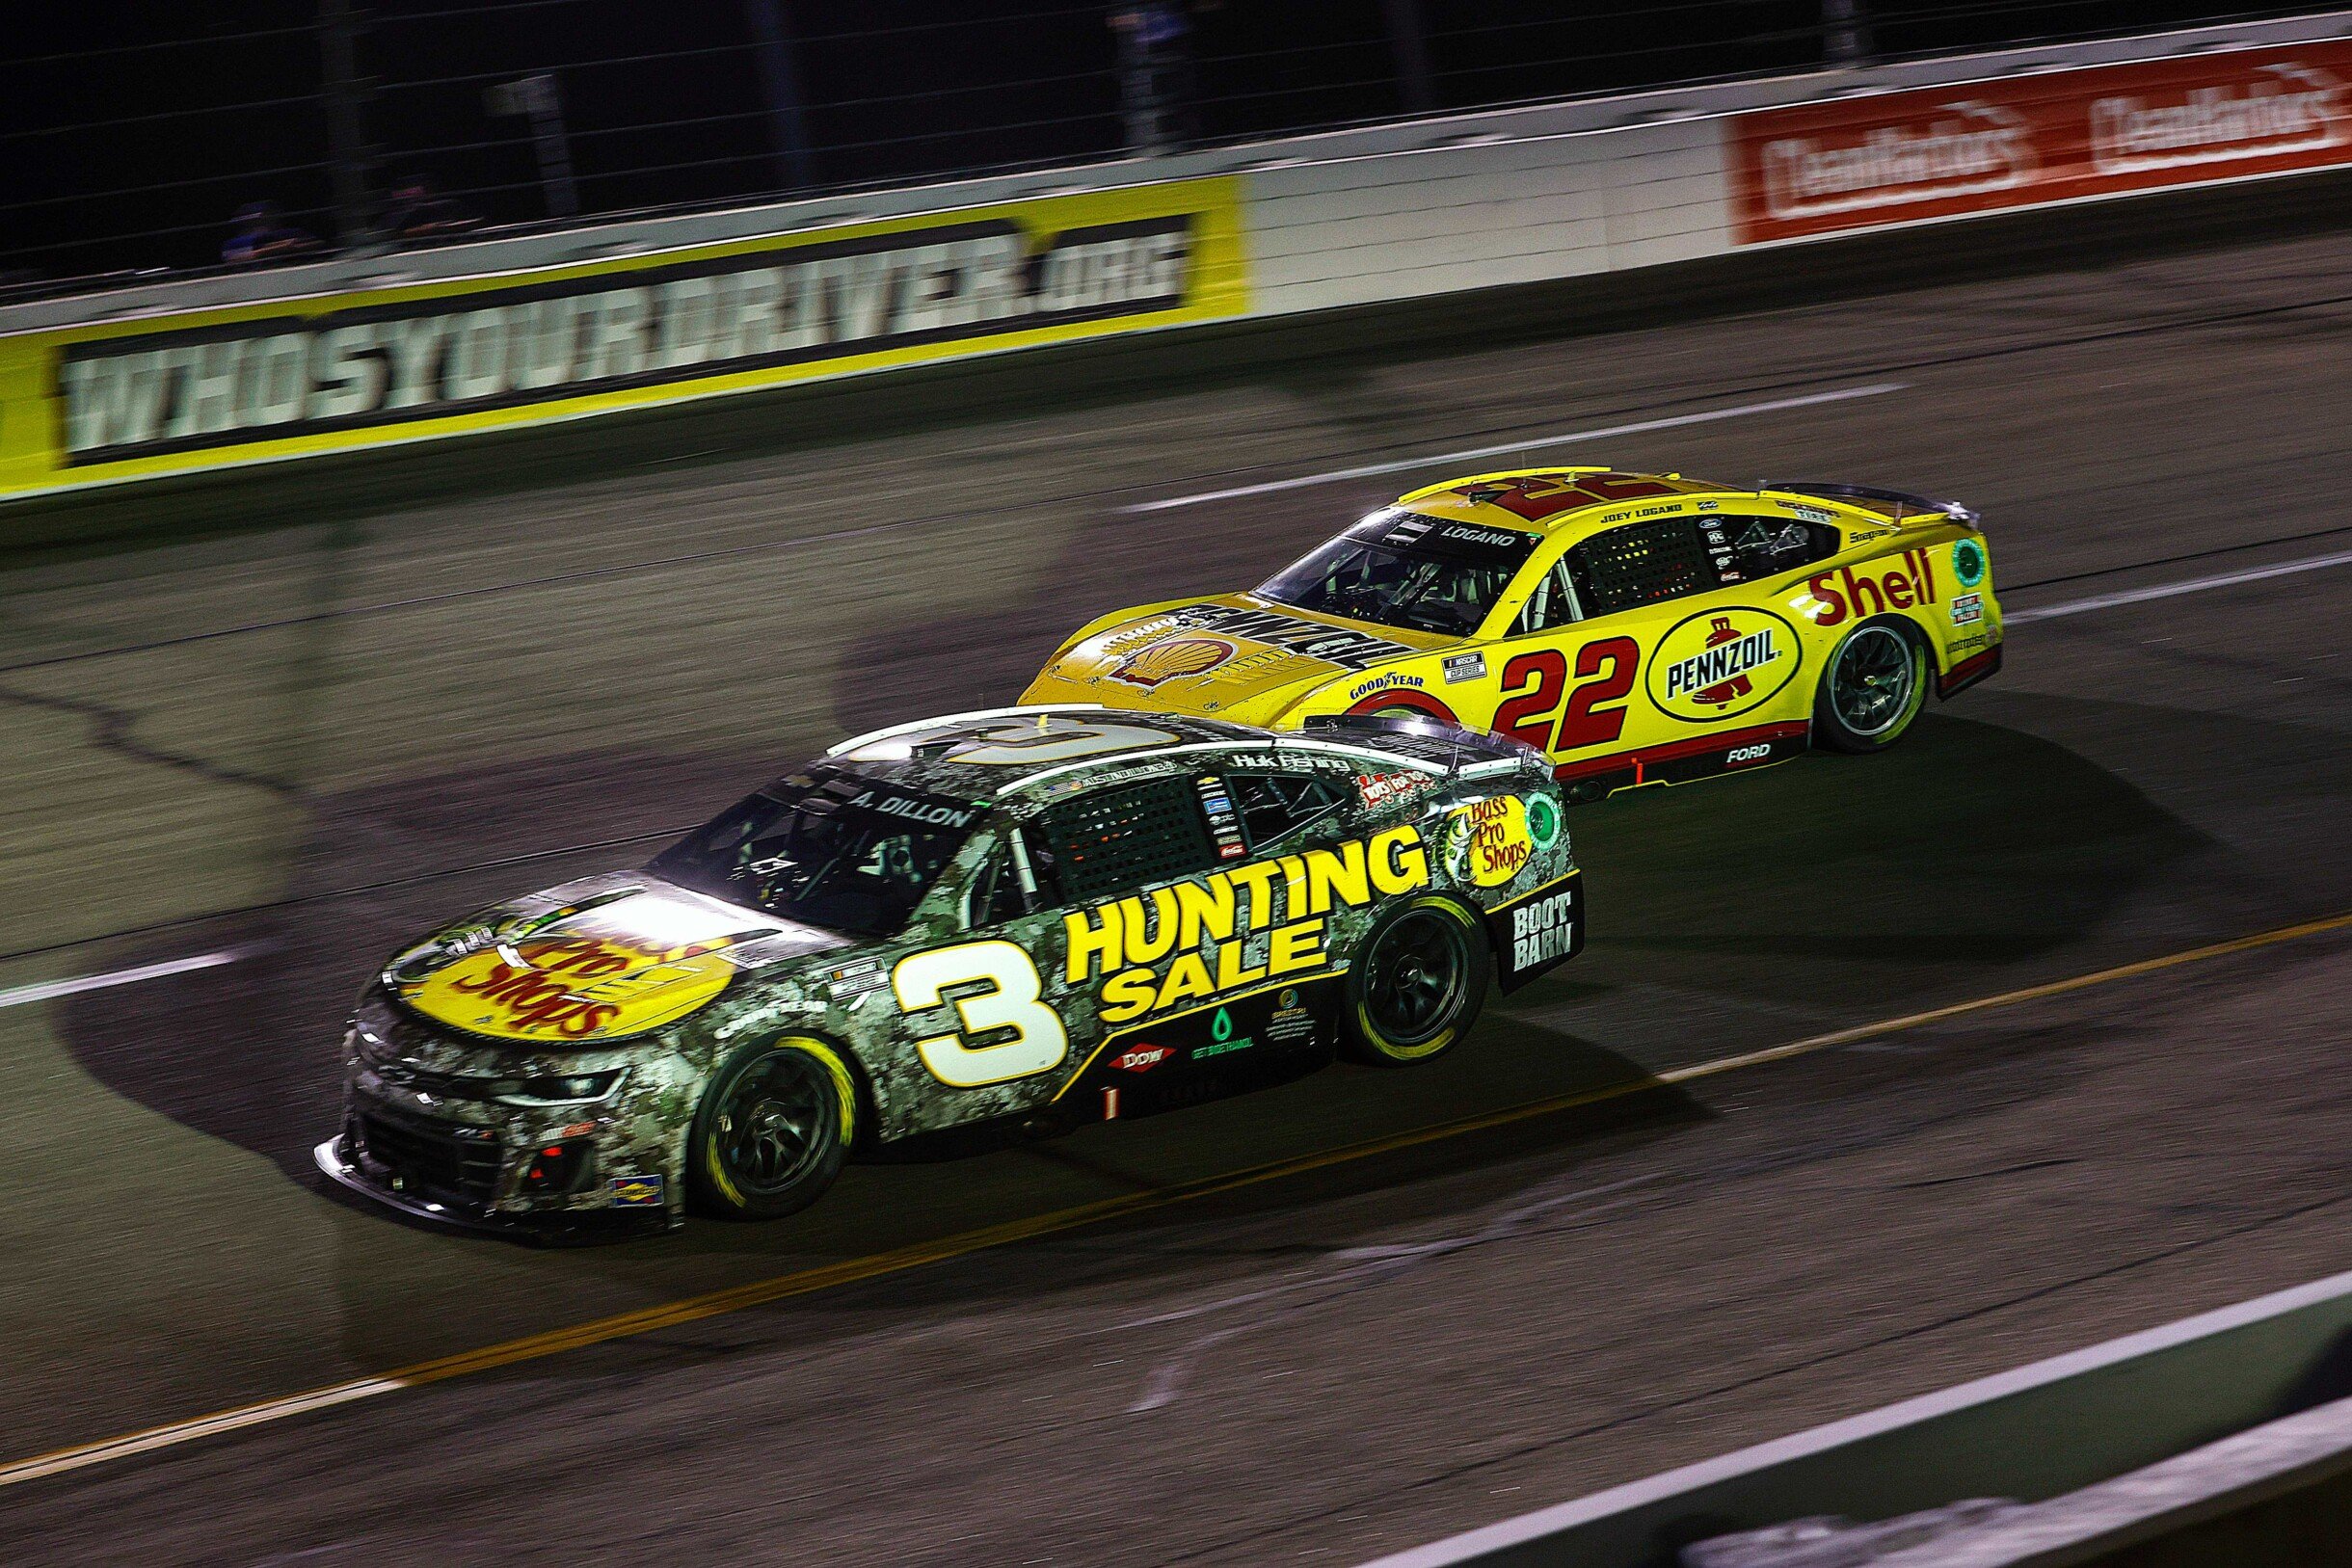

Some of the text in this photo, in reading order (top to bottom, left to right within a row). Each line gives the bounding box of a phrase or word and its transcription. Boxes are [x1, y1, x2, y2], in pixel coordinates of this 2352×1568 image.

[1440, 525, 1516, 546] LOGANO
[1600, 511, 1631, 523] JOEY
[1636, 504, 1682, 517] LOGANO
[1809, 547, 1936, 626] Shell
[1667, 628, 1781, 701] PENNZOIL
[1491, 635, 1641, 753] 22
[1231, 754, 1279, 768] Huk
[1726, 743, 1772, 763] FORD
[847, 790, 972, 828] A. DILLON
[1470, 795, 1508, 824] Bass
[1477, 821, 1506, 846] Pro
[1483, 838, 1527, 872] Shops
[1062, 824, 1430, 984] HUNTING
[1513, 890, 1572, 941] BOOT
[1099, 917, 1328, 1023] SALE
[1513, 921, 1573, 972] BARN
[449, 964, 623, 1039] Shops
[890, 939, 1070, 1088] 3
